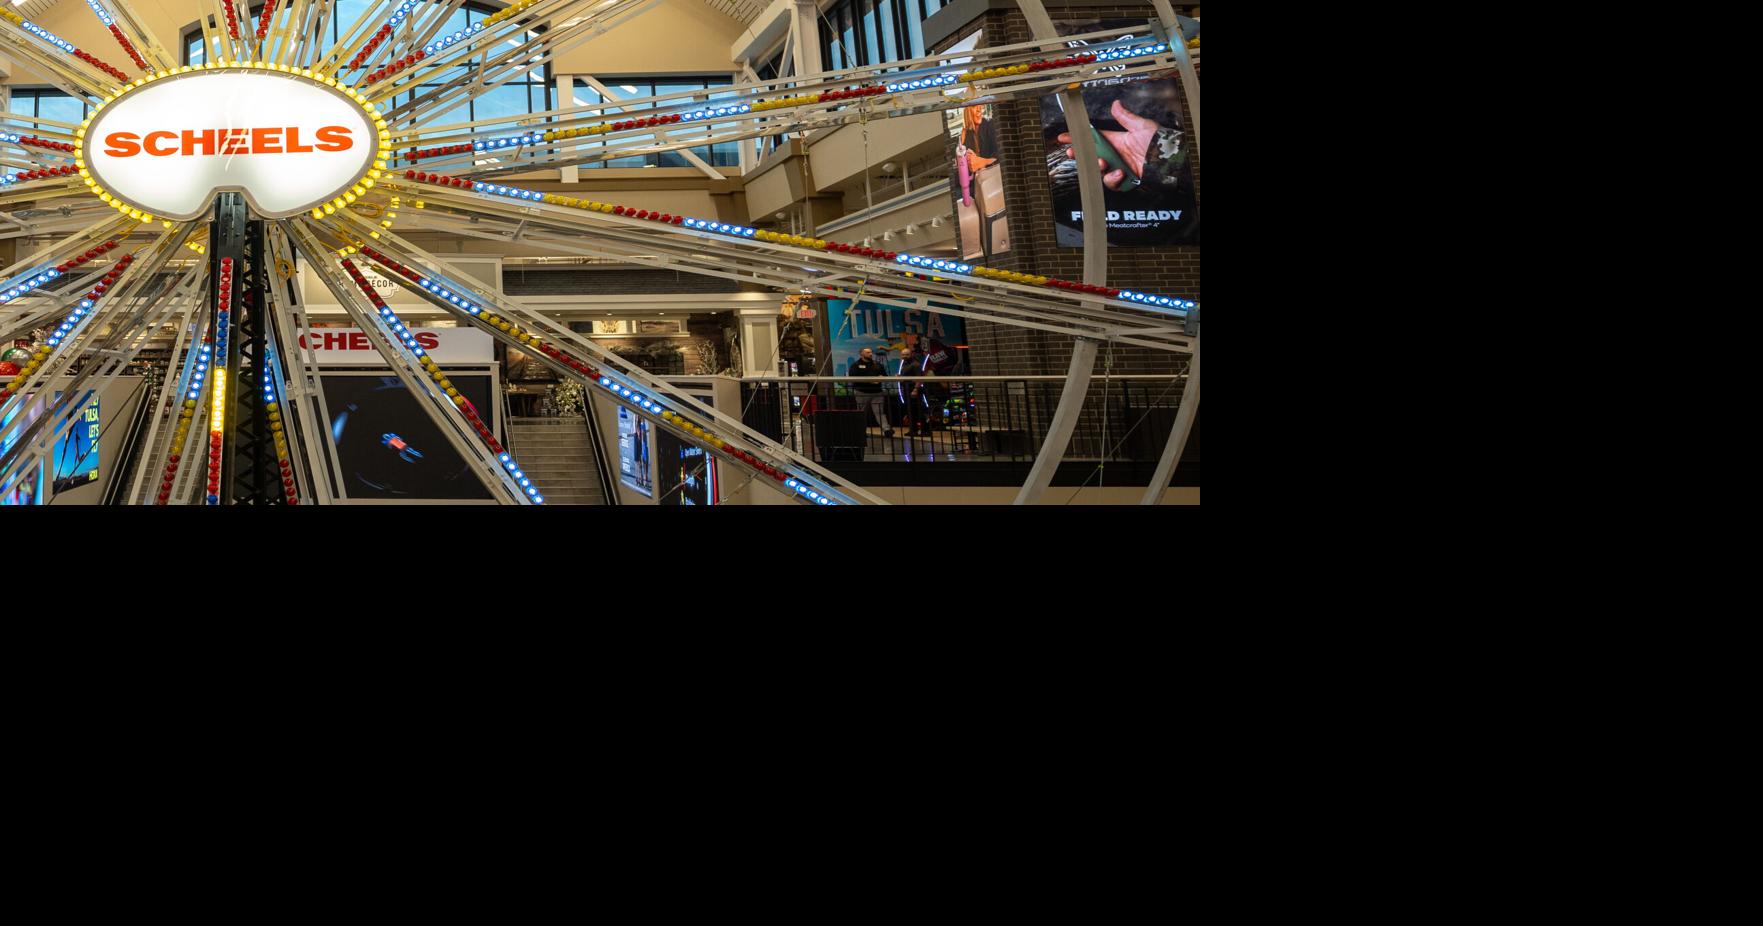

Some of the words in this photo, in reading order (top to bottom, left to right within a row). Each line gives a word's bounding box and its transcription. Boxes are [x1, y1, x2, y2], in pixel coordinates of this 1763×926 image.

[104, 125, 354, 158] SCHEELS
[1123, 210, 1182, 221] READY
[849, 309, 945, 339] TULSA
